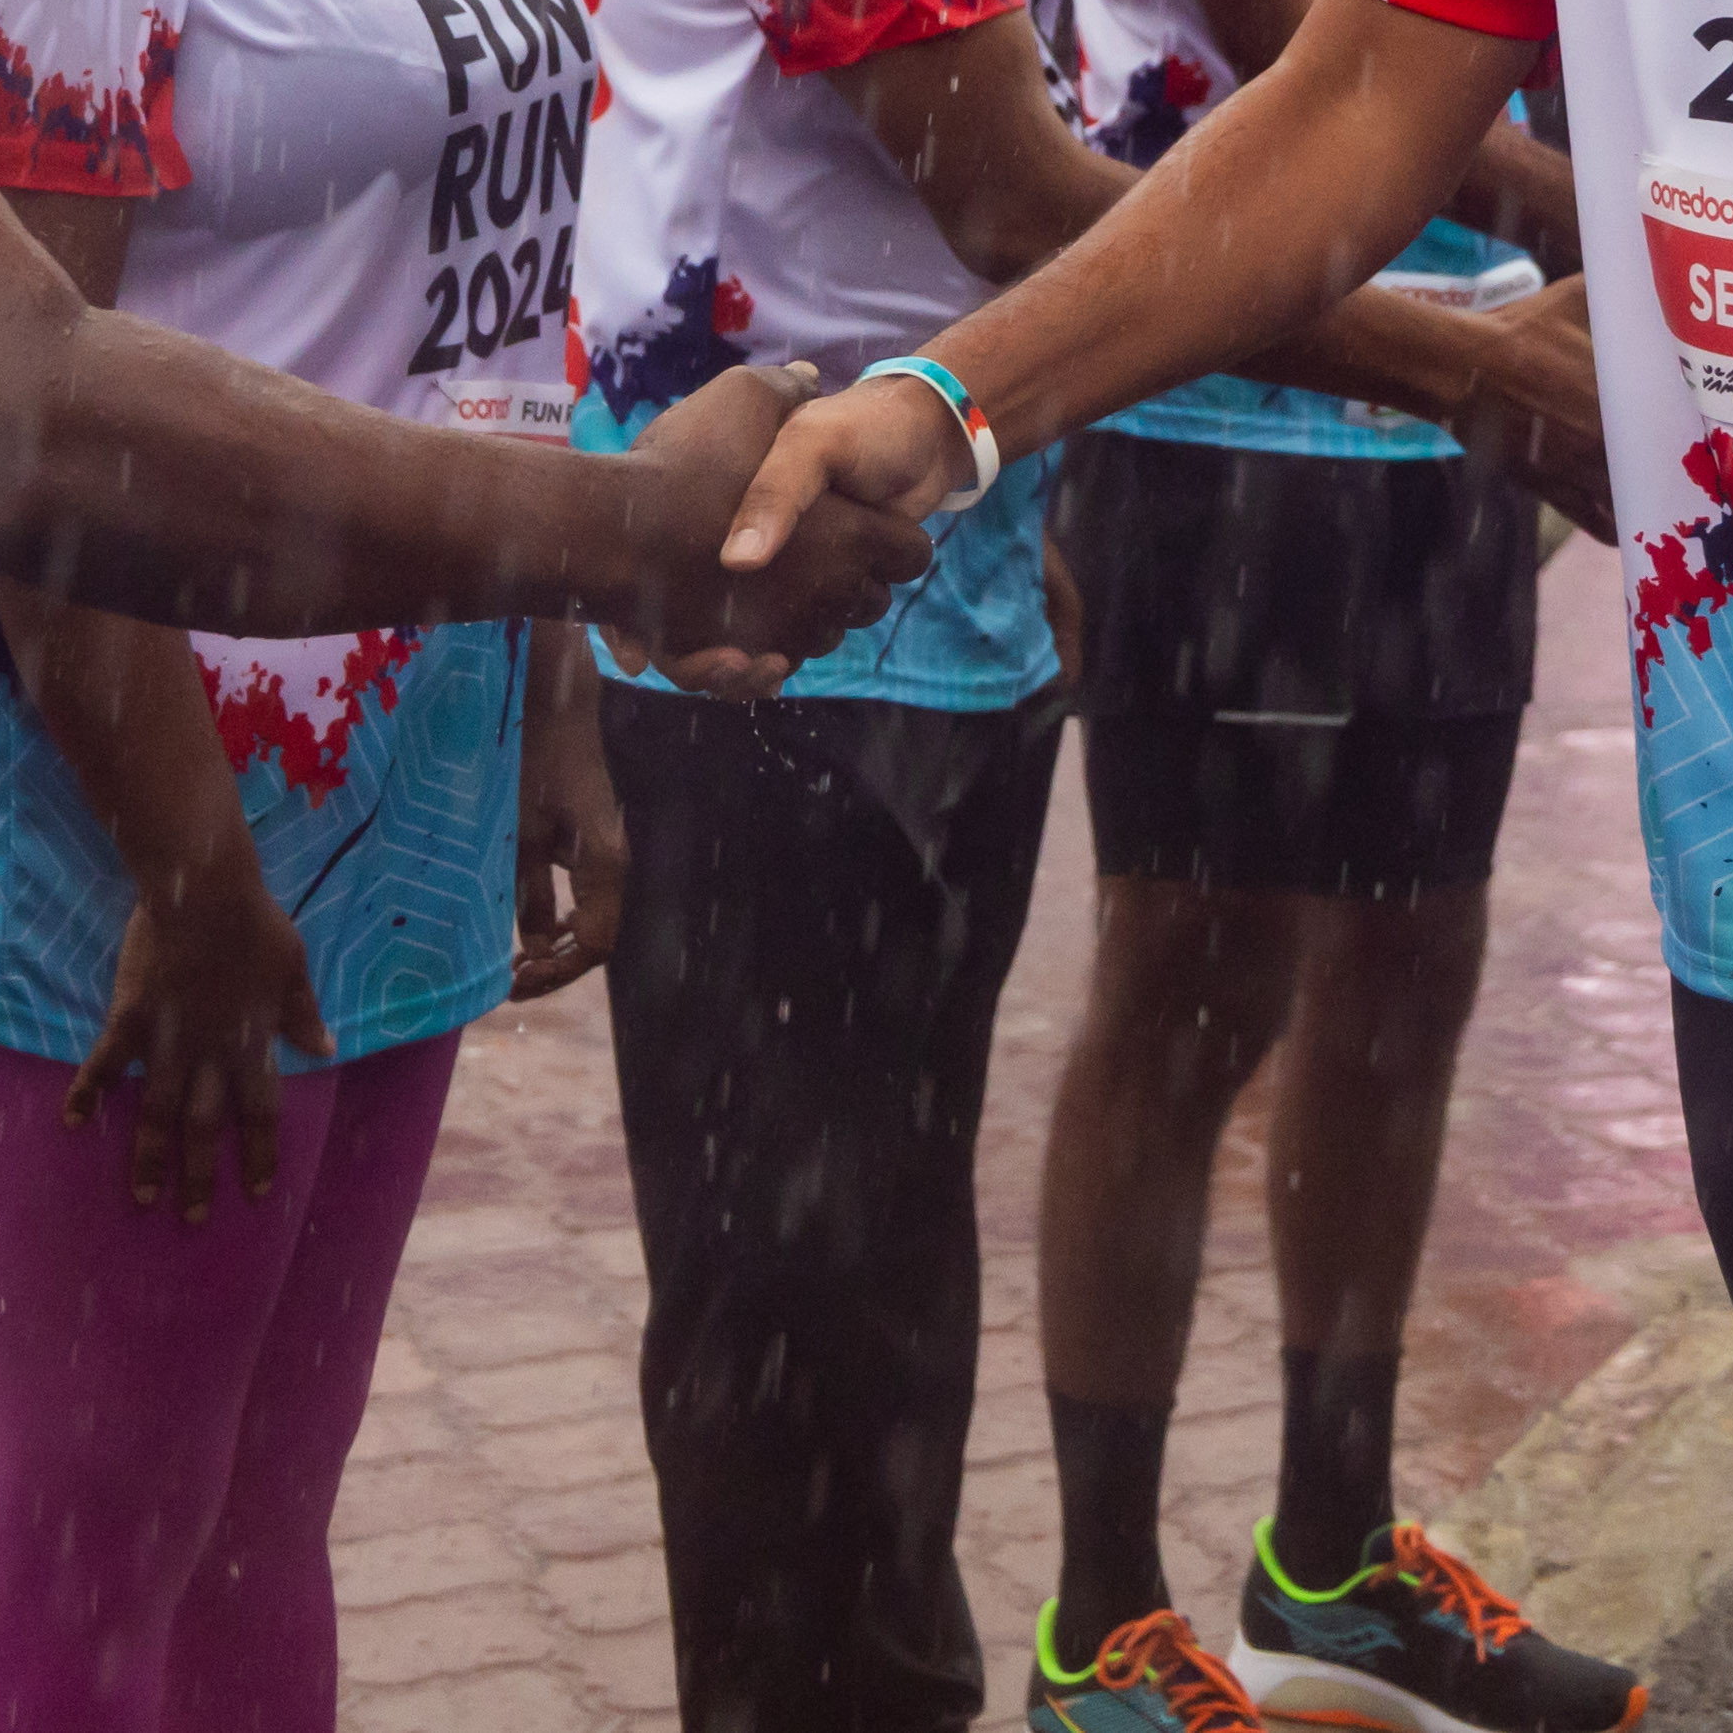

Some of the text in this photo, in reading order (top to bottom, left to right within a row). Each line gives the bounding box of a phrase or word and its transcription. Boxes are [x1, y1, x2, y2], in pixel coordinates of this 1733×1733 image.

[428, 79, 594, 255] RUN
[408, 225, 574, 376] 2024
[522, 400, 562, 423] FUN
